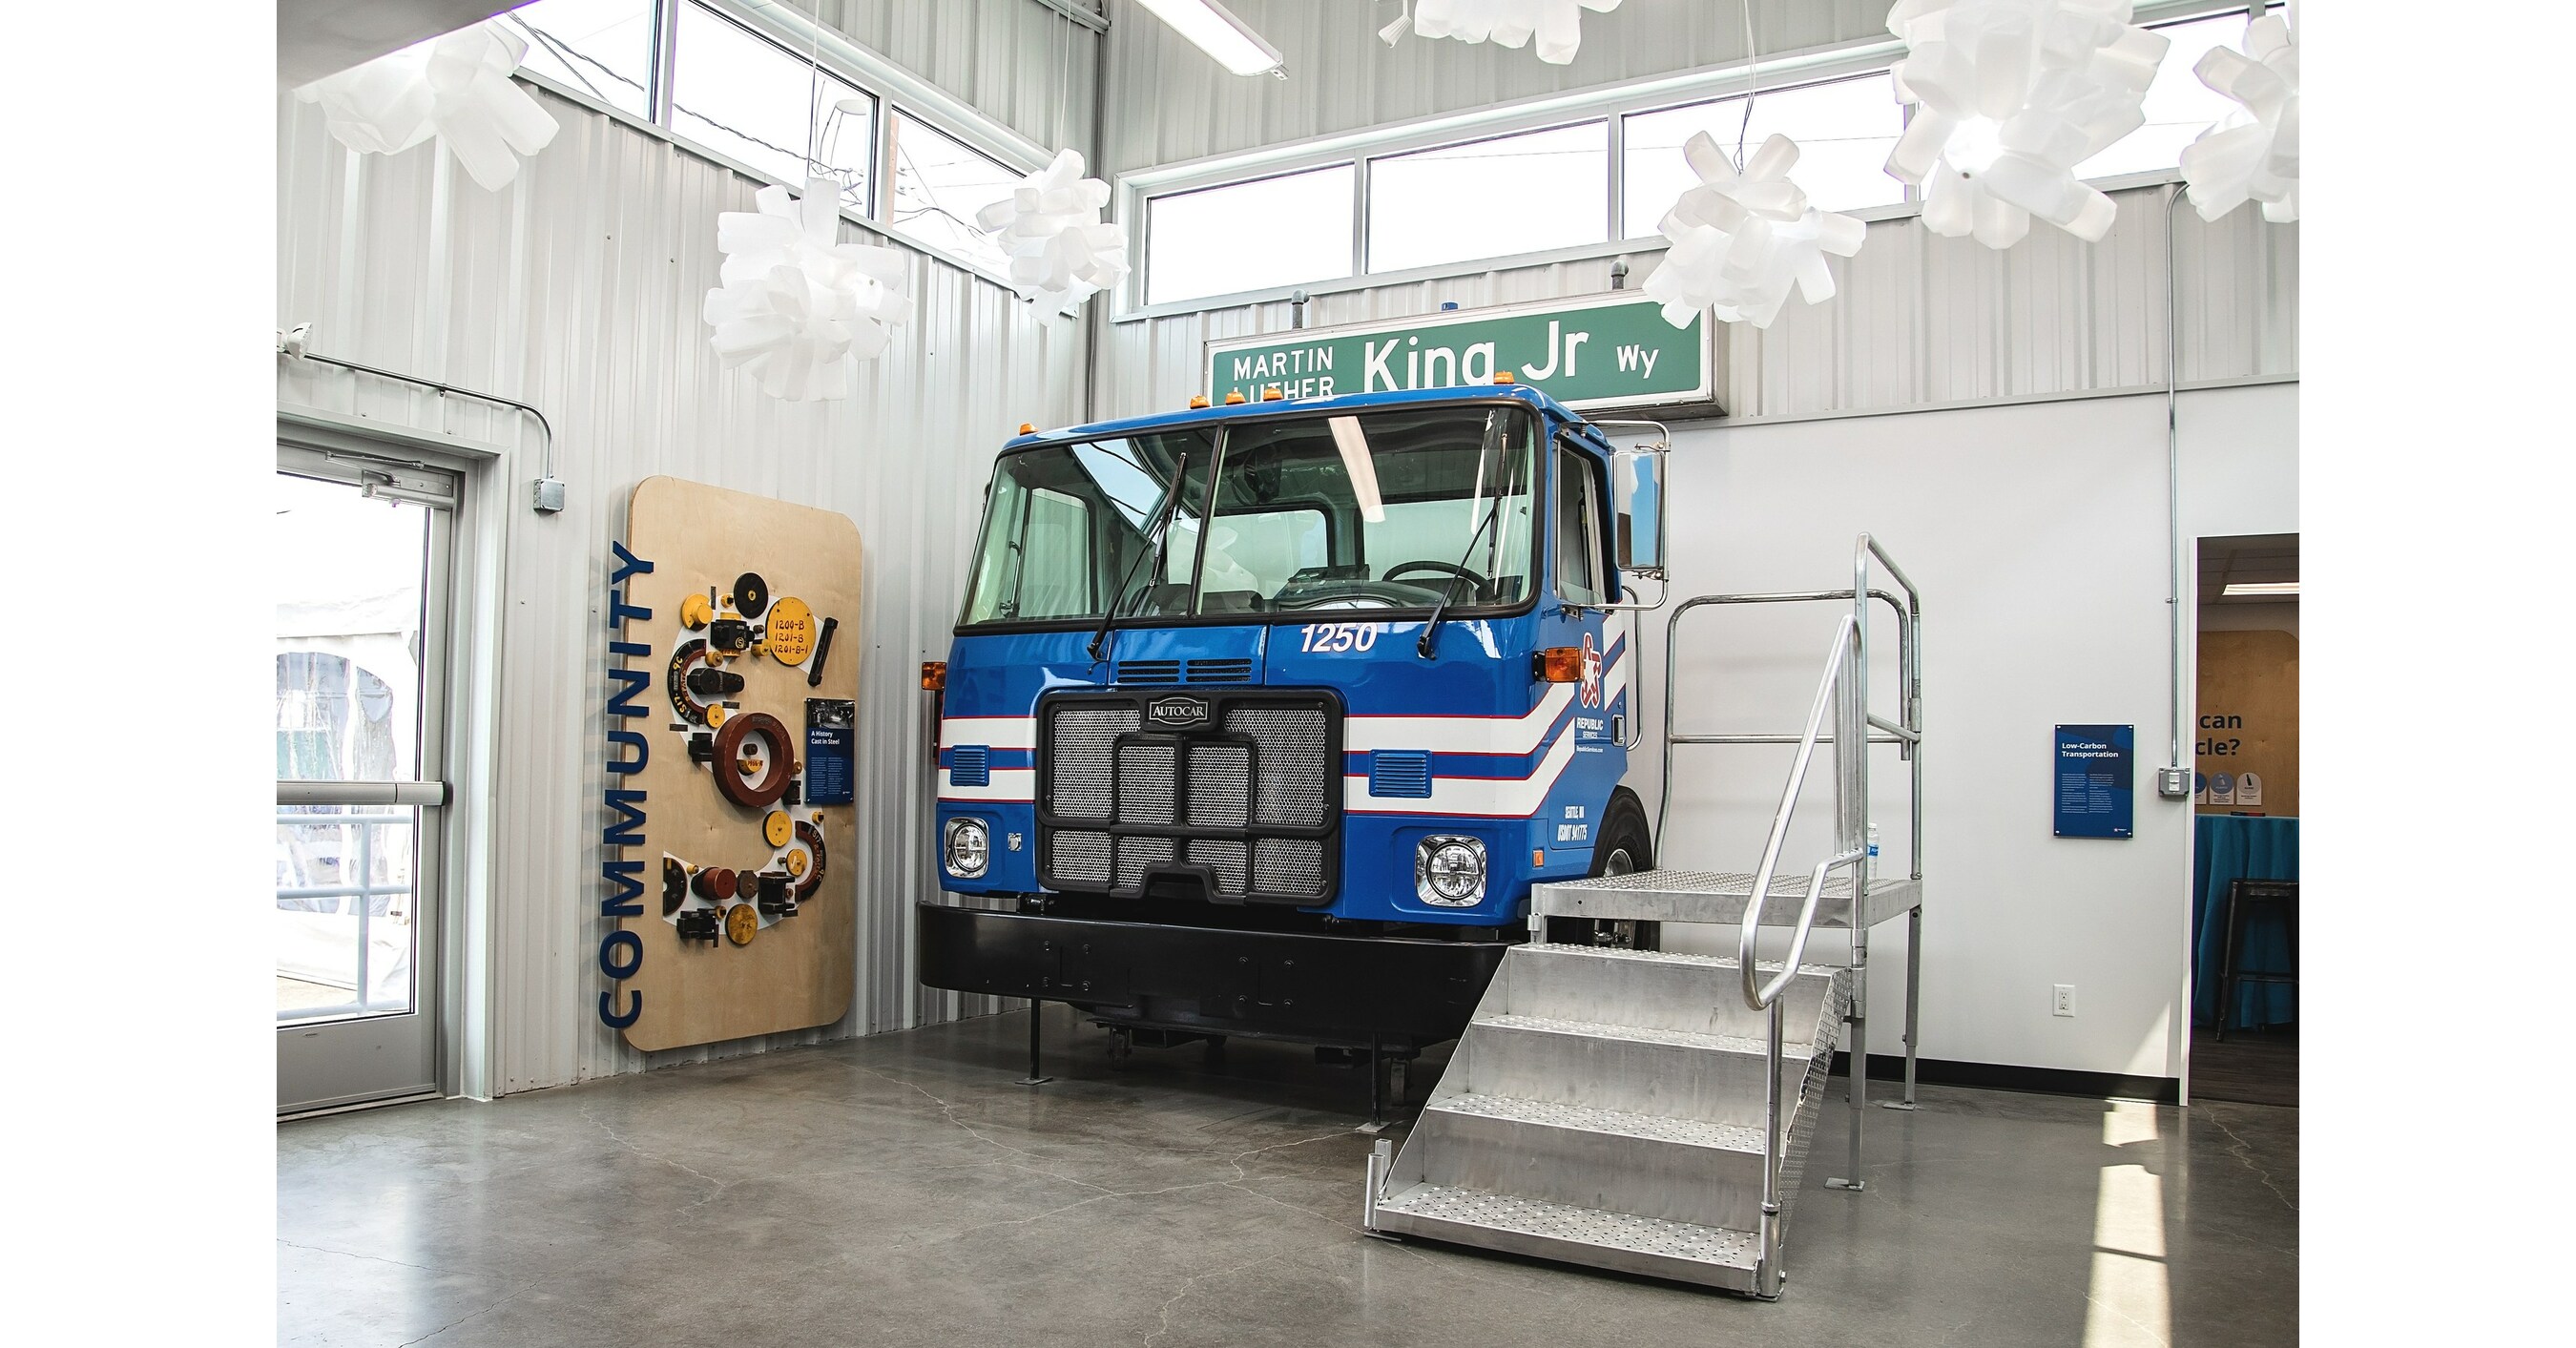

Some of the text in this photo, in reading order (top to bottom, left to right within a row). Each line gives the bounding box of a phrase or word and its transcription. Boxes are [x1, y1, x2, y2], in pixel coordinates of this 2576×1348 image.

[1522, 320, 1590, 381] Jr
[1616, 344, 1659, 379] Wy
[1233, 345, 1334, 381] MARTIN
[1233, 376, 1335, 404] UHER
[775, 620, 805, 631] 1200-B
[775, 633, 804, 643] 1201-B
[1300, 623, 1379, 653] 1250
[774, 644, 809, 654] 1201-B-1
[1152, 705, 1205, 716] AUTOCAR
[1576, 716, 1604, 731] REPUBLIC
[2199, 715, 2242, 729] can
[816, 730, 834, 738] History
[599, 540, 654, 1029] COMMUNITY
